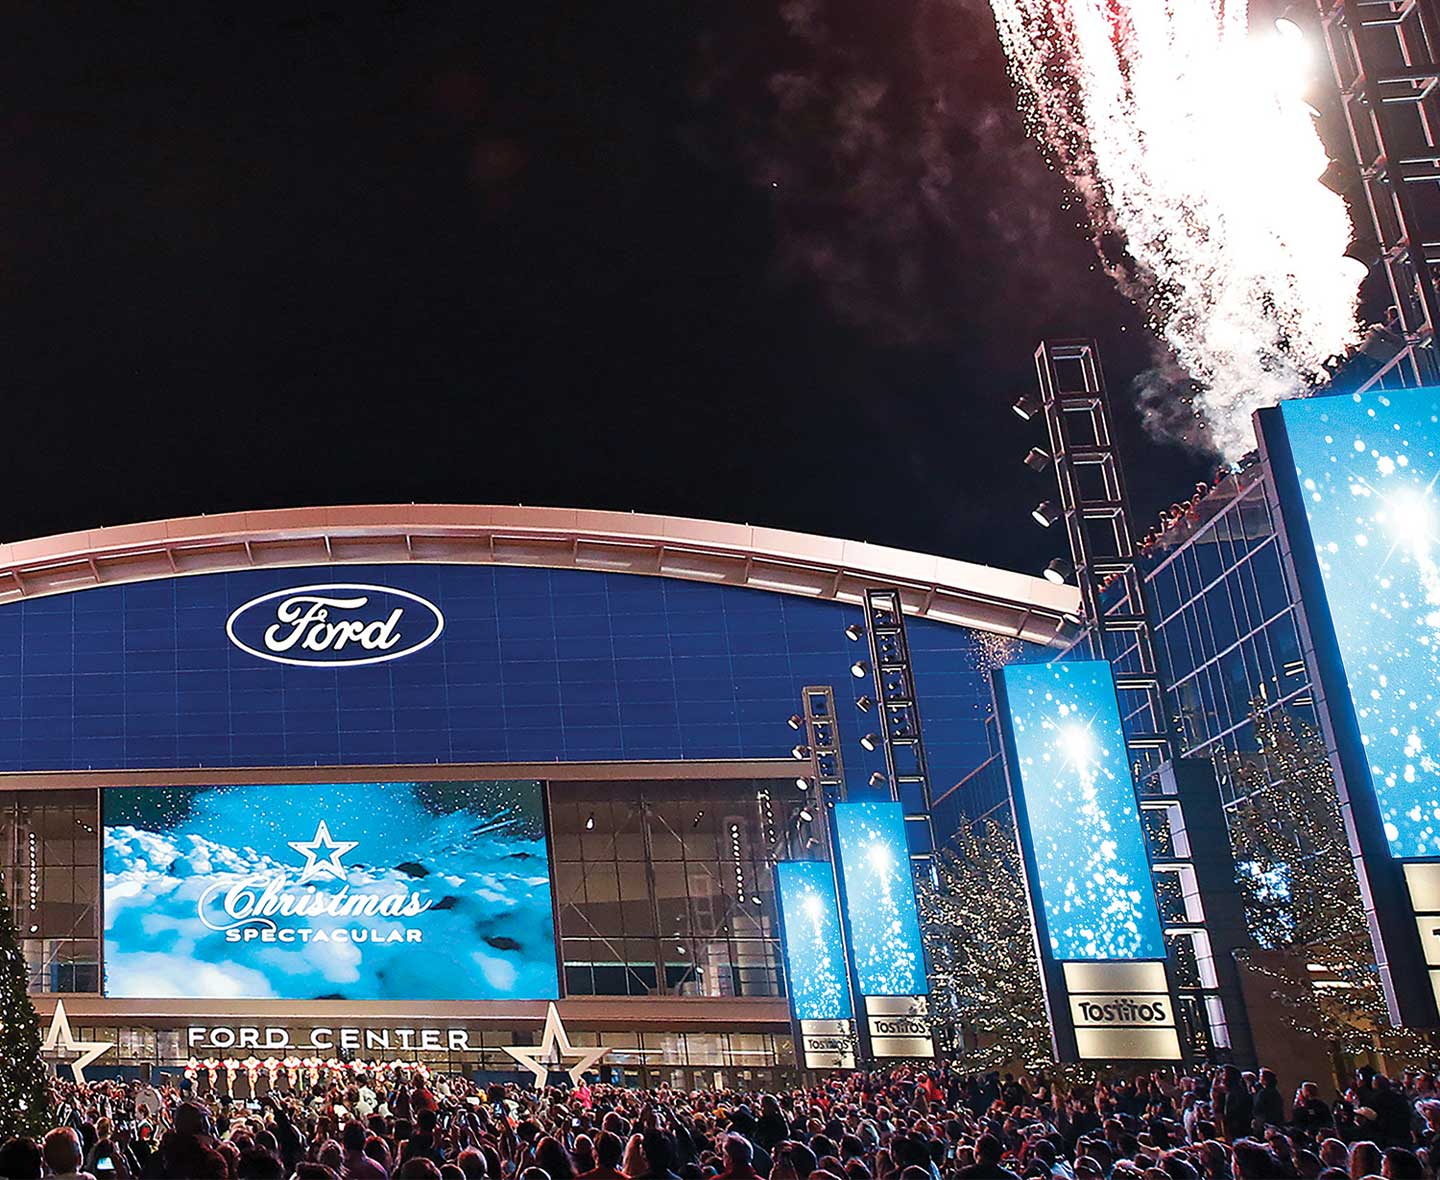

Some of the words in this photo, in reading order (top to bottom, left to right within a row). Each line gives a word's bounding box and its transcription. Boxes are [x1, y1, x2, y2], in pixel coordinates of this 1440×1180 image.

[264, 596, 404, 652] Ford
[198, 872, 433, 930] Christmas
[225, 928, 423, 943] SPECTACULAR
[187, 1027, 290, 1049] FORD
[310, 1028, 470, 1050] CENTER
